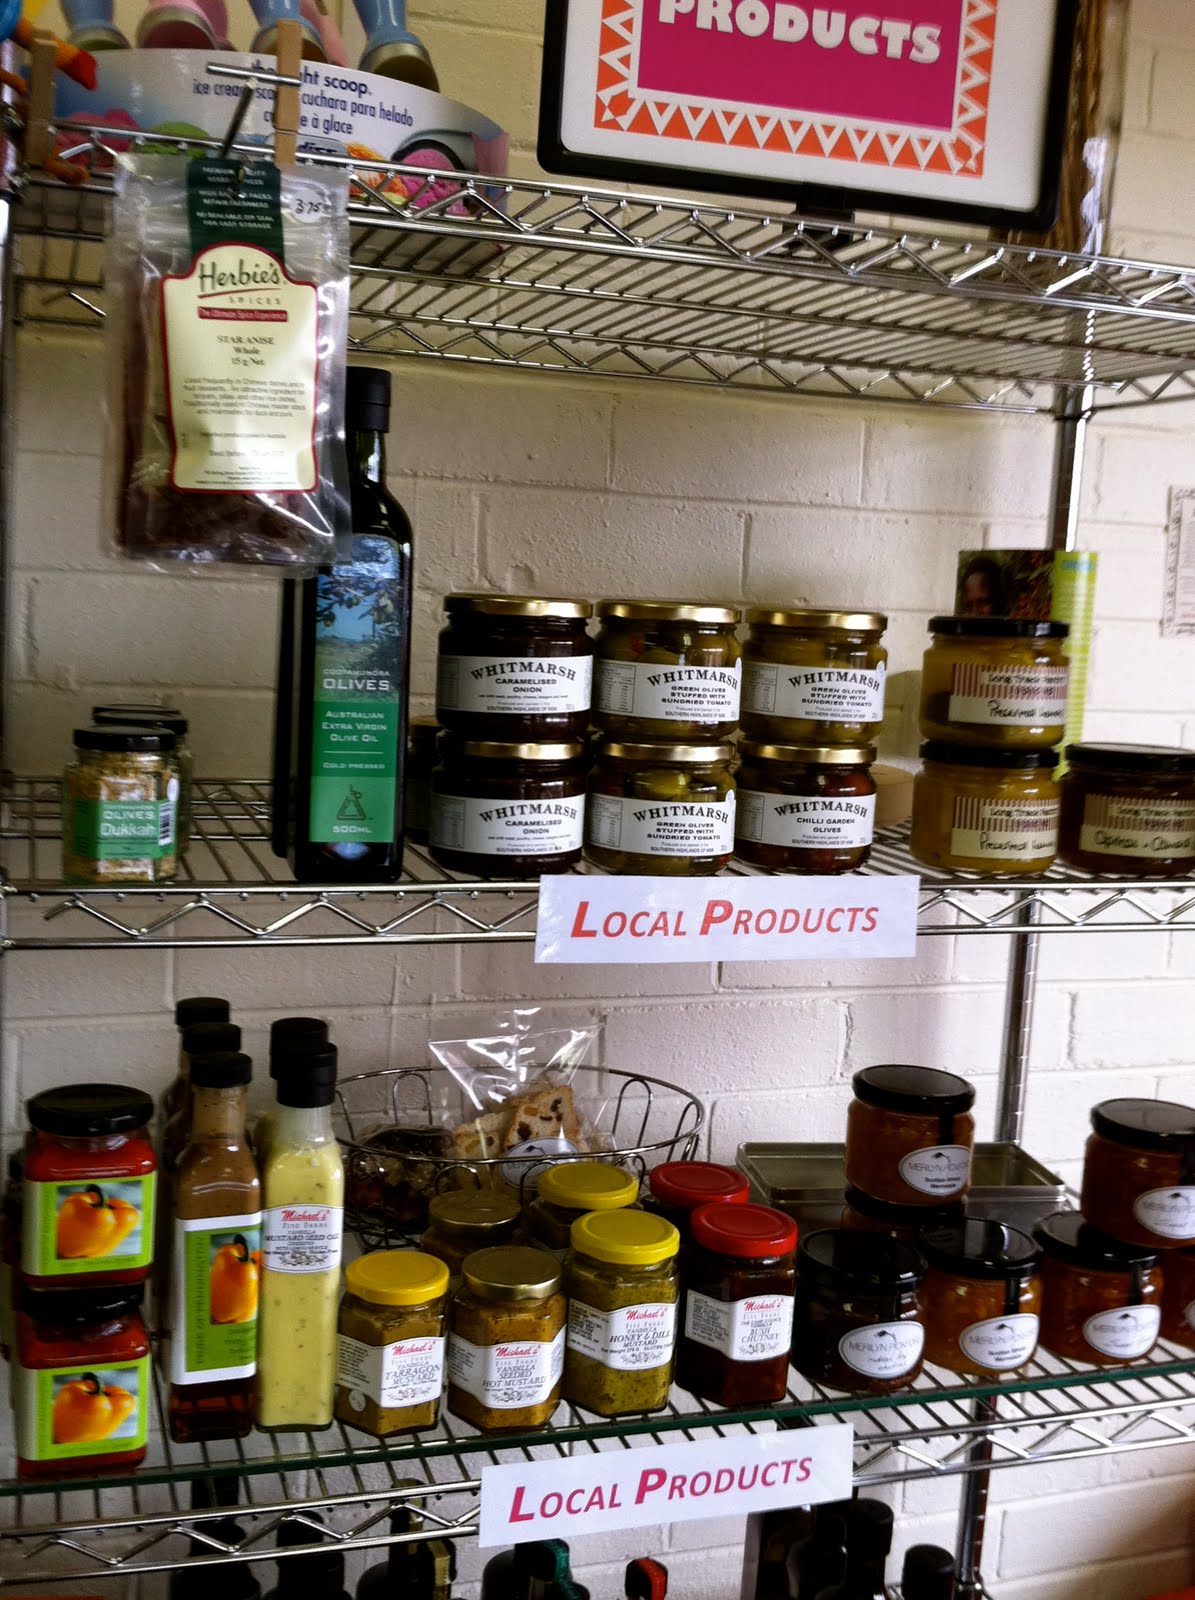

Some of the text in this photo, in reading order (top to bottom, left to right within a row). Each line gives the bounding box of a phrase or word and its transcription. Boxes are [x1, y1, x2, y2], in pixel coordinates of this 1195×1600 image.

[658, 0, 942, 64] PRODUCTS
[193, 79, 209, 94] ice
[213, 83, 246, 97] crea
[301, 89, 347, 111] cuchara
[350, 101, 376, 116] para
[379, 101, 413, 126] helado
[323, 113, 352, 134] glace
[198, 258, 281, 292] Herbie's
[228, 296, 281, 305] SPICES
[217, 335, 243, 343] STAR
[232, 346, 261, 354] Whole
[470, 661, 577, 682] WHITMARSH
[322, 678, 391, 691] OLIVES
[647, 669, 738, 690] WHITMARSH
[788, 671, 881, 692] WHITMARSH
[801, 698, 844, 706] SUNDRIED
[479, 803, 578, 823] WHITMARSH
[632, 805, 729, 824] WHITMARSH
[774, 800, 868, 818] WHITMARSH
[505, 819, 562, 827] CARAMELISED
[796, 817, 824, 825] CHILLI
[646, 833, 691, 841] SUNDRIED
[281, 1209, 327, 1220] Michael's
[743, 1298, 781, 1311] Michael's
[625, 1307, 665, 1320] Michael's
[610, 1333, 642, 1343] HONEY
[651, 1330, 671, 1340] DILL
[741, 1333, 780, 1343] CHUTNEY
[750, 1328, 771, 1336] BUSH
[392, 1342, 433, 1356] Michael's
[623, 1339, 658, 1348] MUSTARD
[848, 1341, 888, 1352] MERILYN
[496, 1346, 538, 1357] Michael's
[385, 1364, 440, 1380] TARRAGON
[393, 1372, 435, 1385] MUSTARD
[499, 1371, 533, 1379] SEEDED
[482, 1375, 547, 1387] HOT MUSTARD
